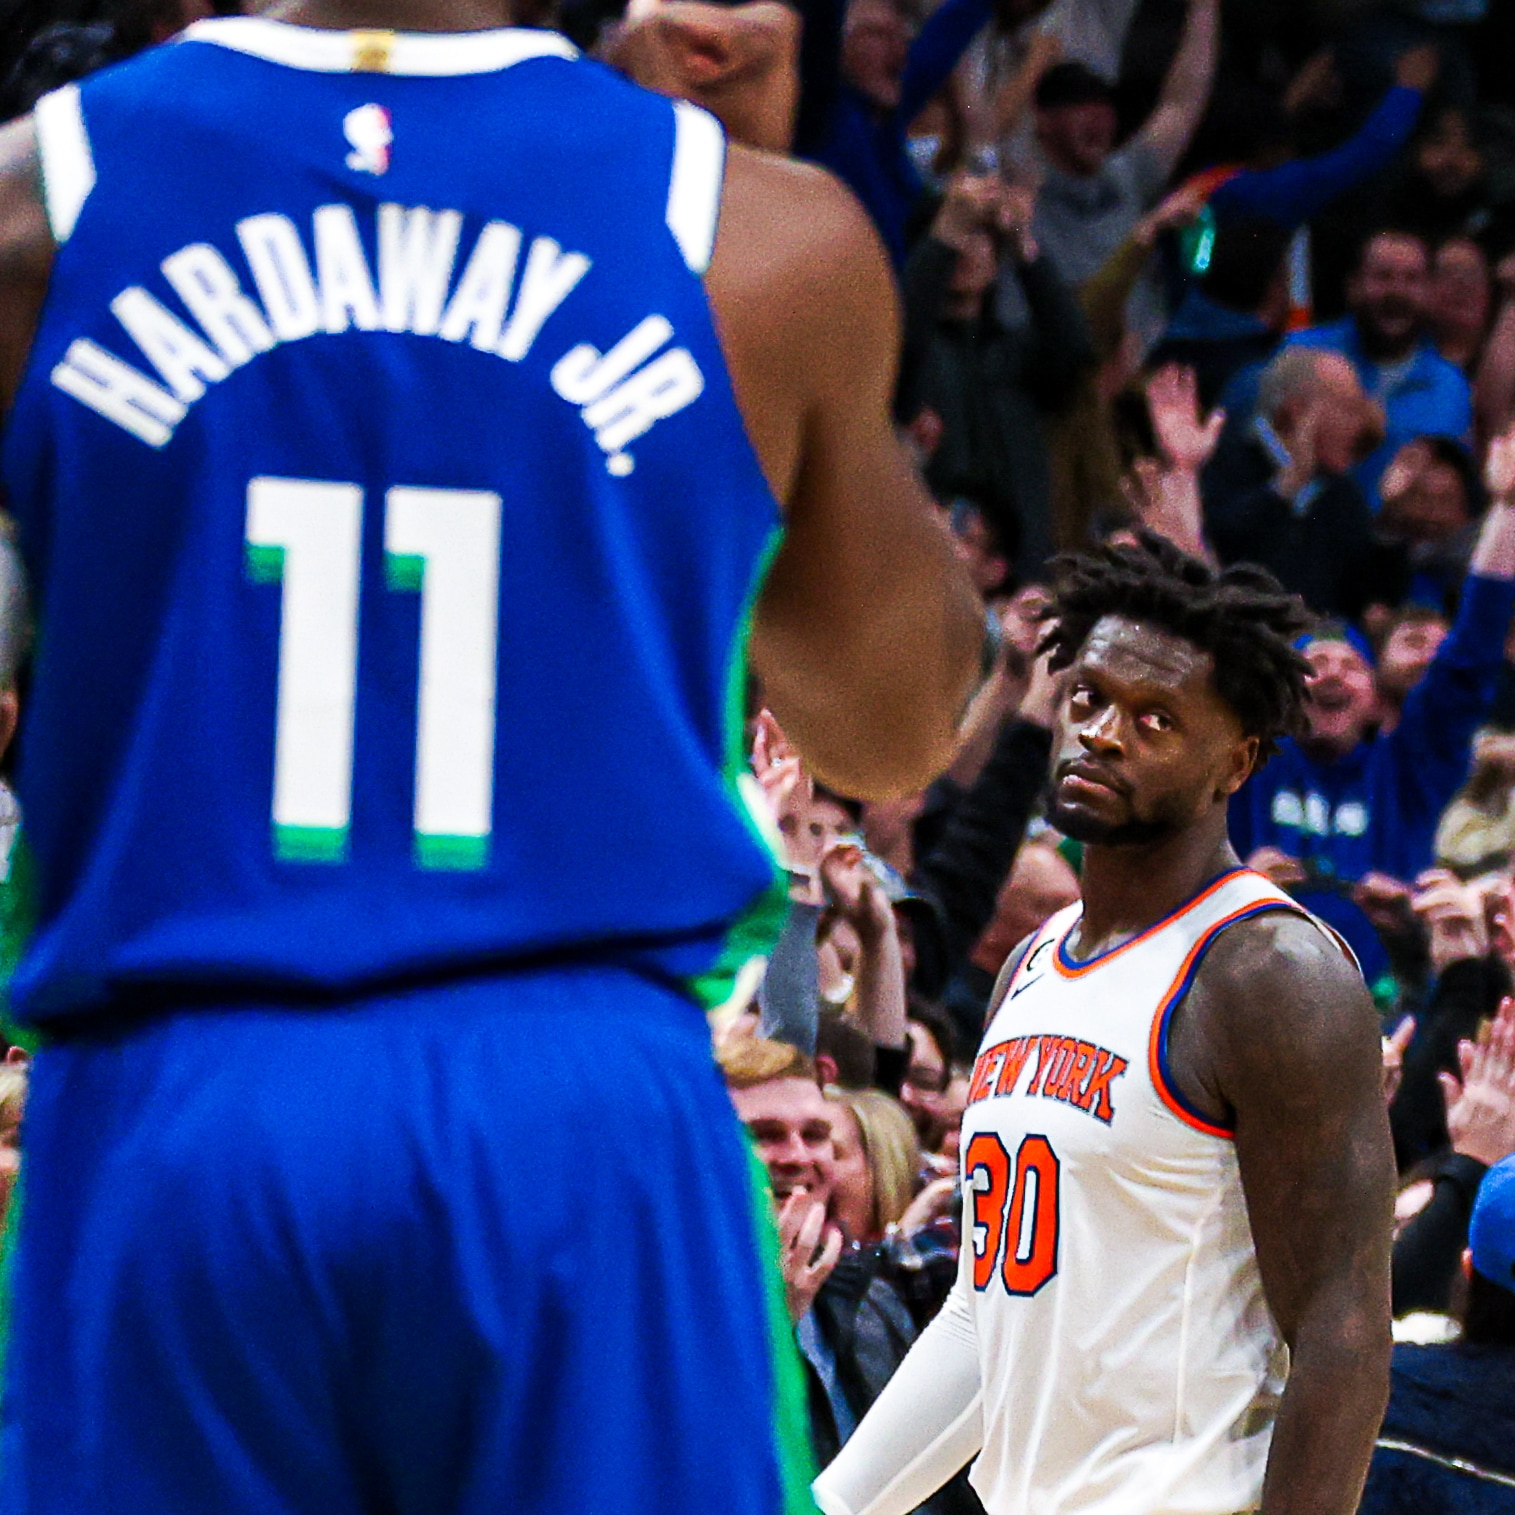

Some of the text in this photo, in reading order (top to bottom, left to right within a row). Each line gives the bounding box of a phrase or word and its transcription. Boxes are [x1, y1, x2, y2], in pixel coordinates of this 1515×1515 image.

[51, 203, 705, 477] HARDAWAY JR.
[246, 475, 503, 871] 11
[1025, 1033, 1130, 1128] YORK
[965, 1131, 1061, 1297] 30
